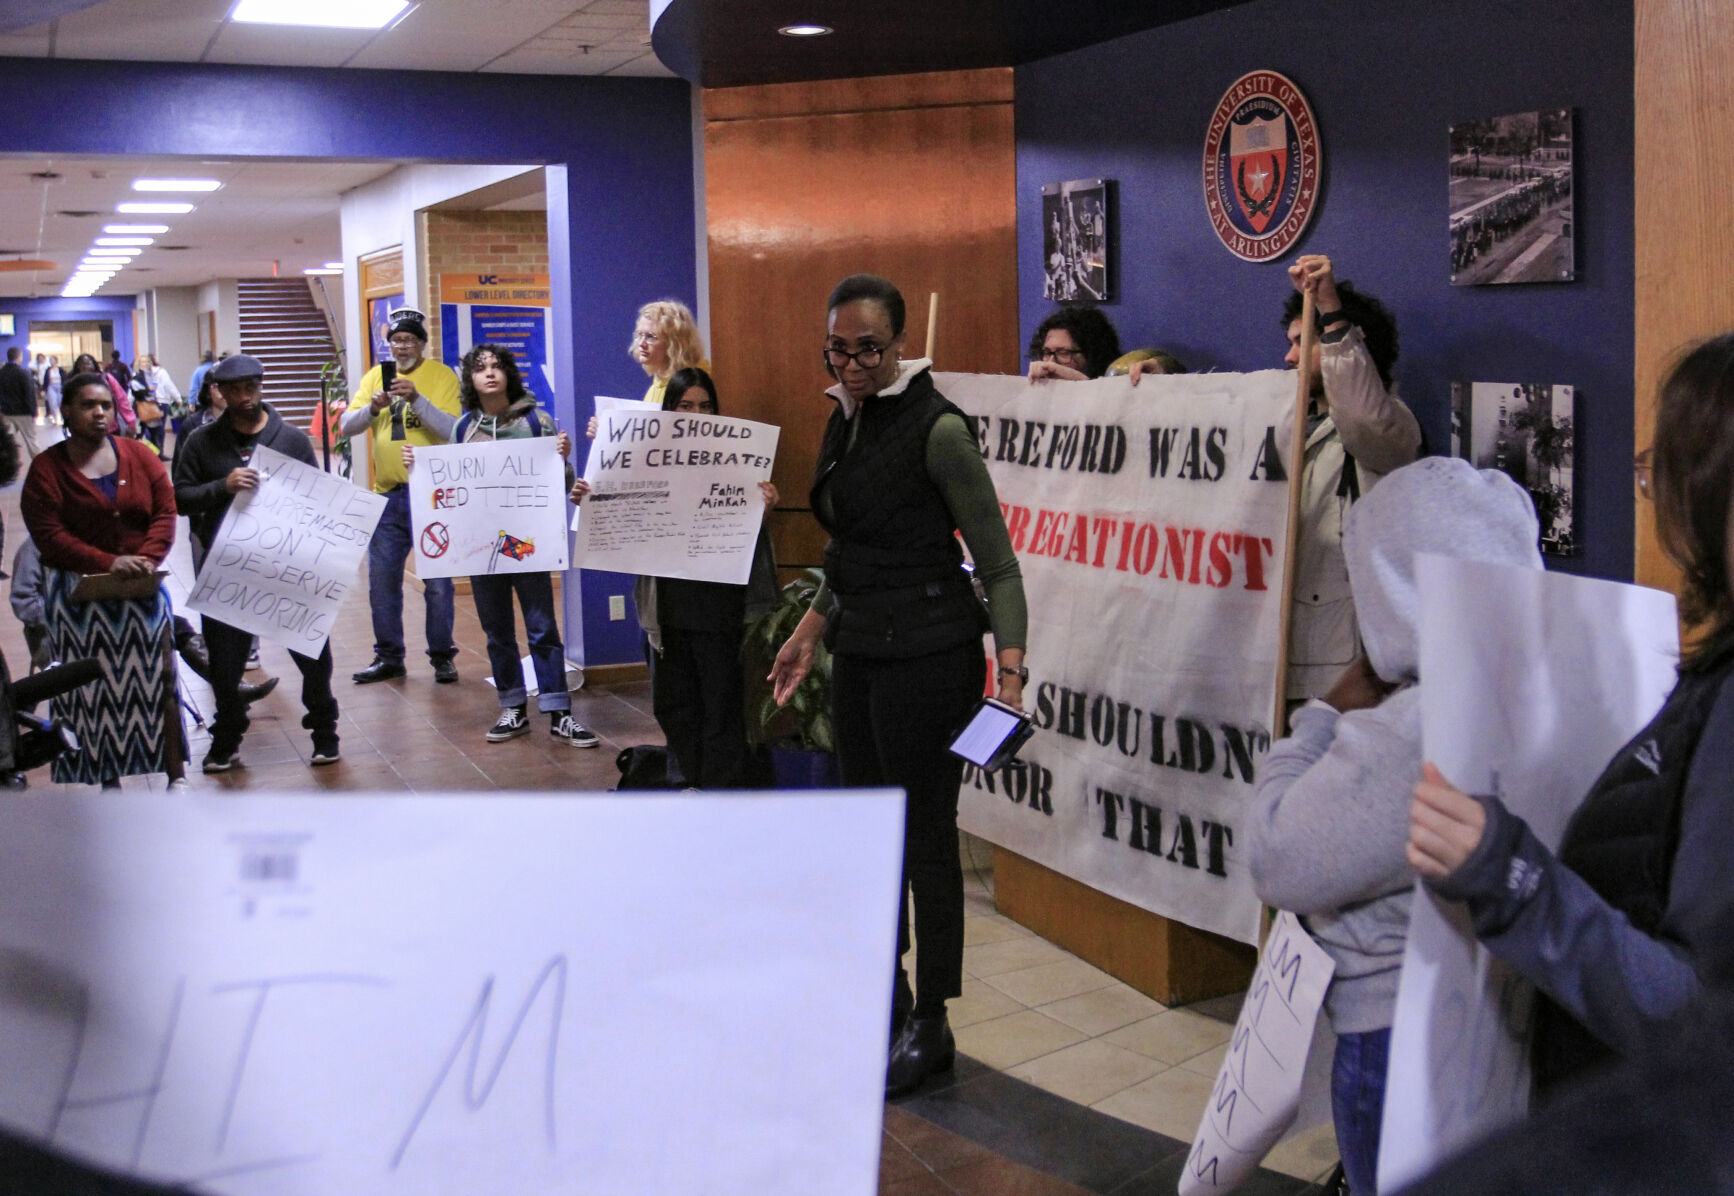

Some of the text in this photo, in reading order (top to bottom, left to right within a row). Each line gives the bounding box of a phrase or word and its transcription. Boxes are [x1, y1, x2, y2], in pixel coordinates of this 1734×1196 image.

[1208, 76, 1275, 146] UNIVERSITY
[1279, 84, 1298, 106] OF
[1294, 107, 1315, 179] TEXAS
[1214, 205, 1306, 257] AT ARLINGTON
[464, 290, 549, 300] LOWER LEVEL DIRECTORY
[478, 275, 498, 285] UC
[608, 417, 752, 443] WHO SHOULD
[1150, 427, 1227, 482] WAS
[1250, 426, 1288, 482] A
[258, 451, 373, 517] WHITE
[429, 455, 542, 485] BURN ALL
[600, 449, 771, 470] WE CELEBRATE?
[433, 485, 549, 509] RED TIES
[710, 483, 745, 496] Fahim
[227, 512, 337, 565] DON'T
[998, 502, 1273, 591] REGATIONIST
[215, 543, 347, 601] DESERVE
[195, 571, 326, 641] HONORING
[1097, 788, 1233, 878] THAT
